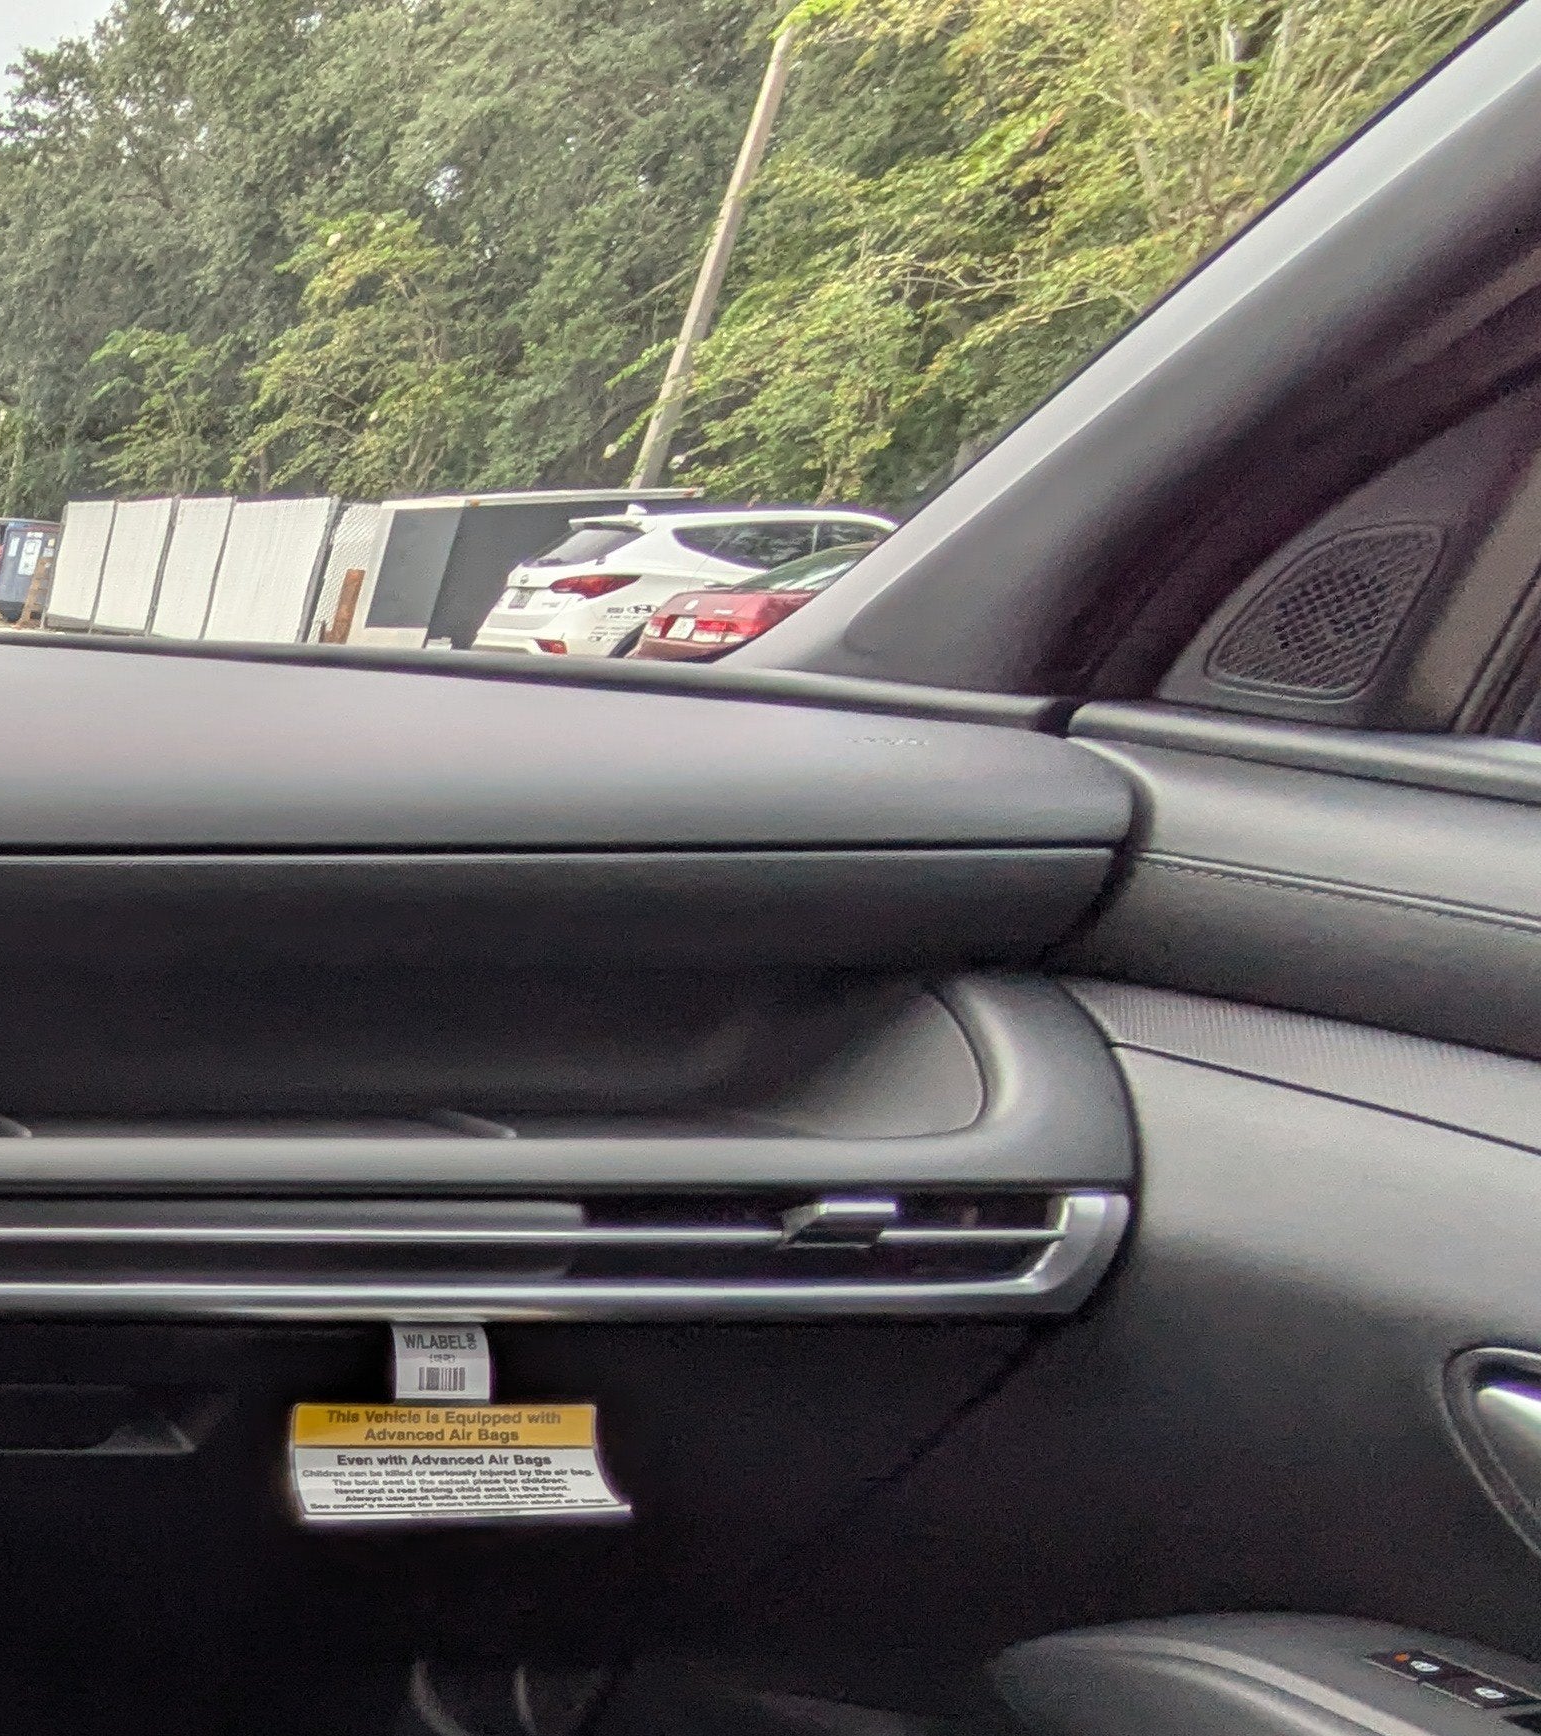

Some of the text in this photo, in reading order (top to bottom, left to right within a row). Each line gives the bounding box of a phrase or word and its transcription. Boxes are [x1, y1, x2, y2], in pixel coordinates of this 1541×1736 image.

[327, 1410, 562, 1426] This Vehicle is Equipped with
[364, 1428, 520, 1443] Advanced Air Bags
[337, 1454, 552, 1467] Even with Advanced Air Bags
